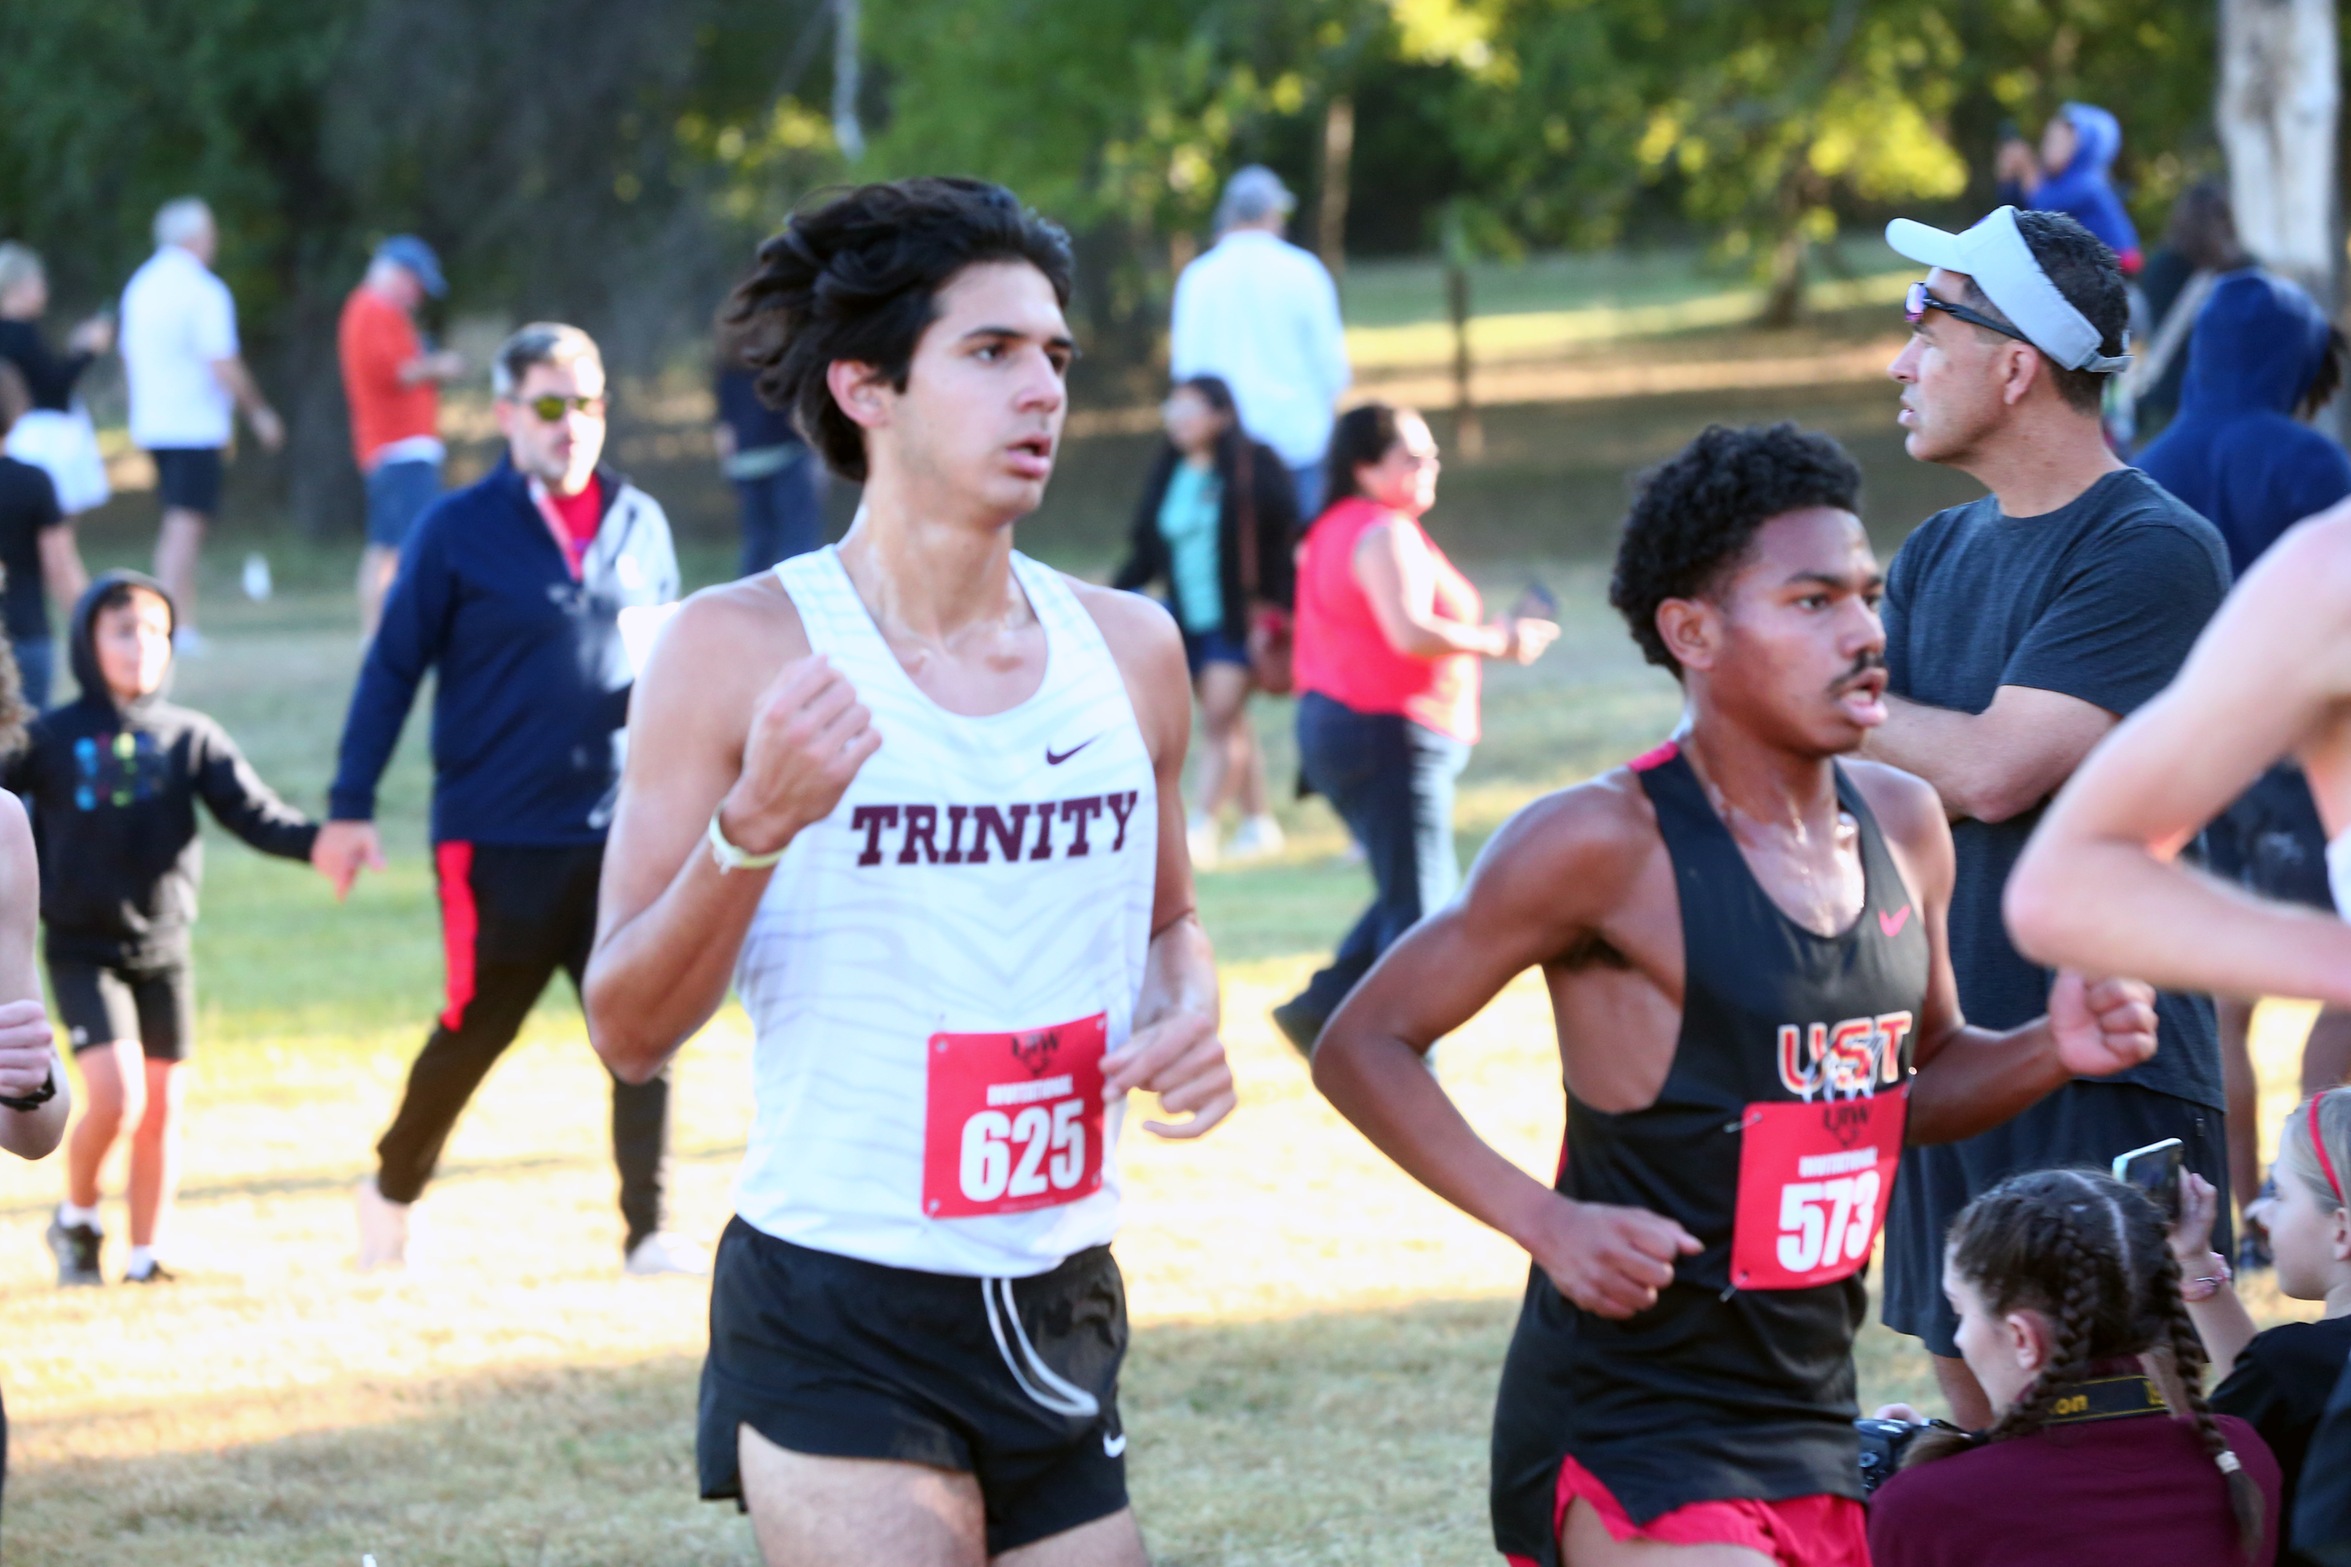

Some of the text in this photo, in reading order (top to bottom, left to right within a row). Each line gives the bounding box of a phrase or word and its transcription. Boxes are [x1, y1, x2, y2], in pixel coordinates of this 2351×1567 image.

[851, 789, 1139, 867] TRINITY
[1777, 1010, 1912, 1096] UST
[959, 1098, 1086, 1202] 625
[1776, 1170, 1881, 1273] 573
